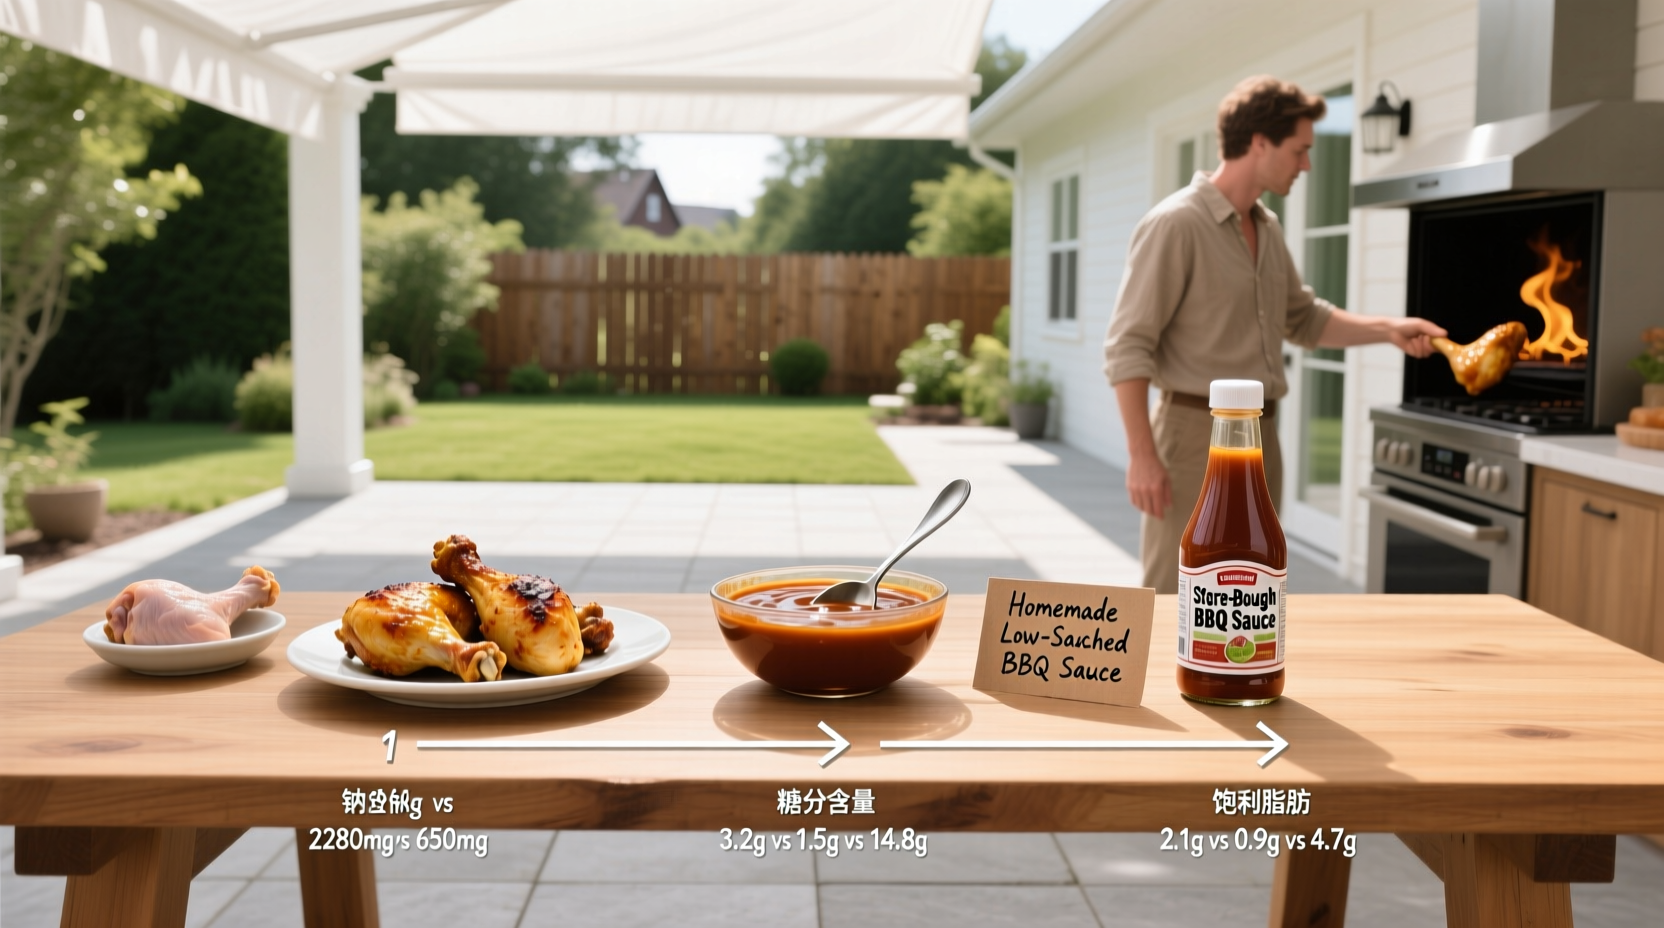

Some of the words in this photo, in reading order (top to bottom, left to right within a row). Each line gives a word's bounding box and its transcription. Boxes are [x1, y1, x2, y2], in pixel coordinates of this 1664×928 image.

[1008, 590, 1118, 622] Homemade
[1194, 607, 1227, 632] BBQ
[1231, 609, 1276, 630] Sauce
[1001, 651, 1049, 682] BBQ
[1059, 656, 1122, 682] Sauce
